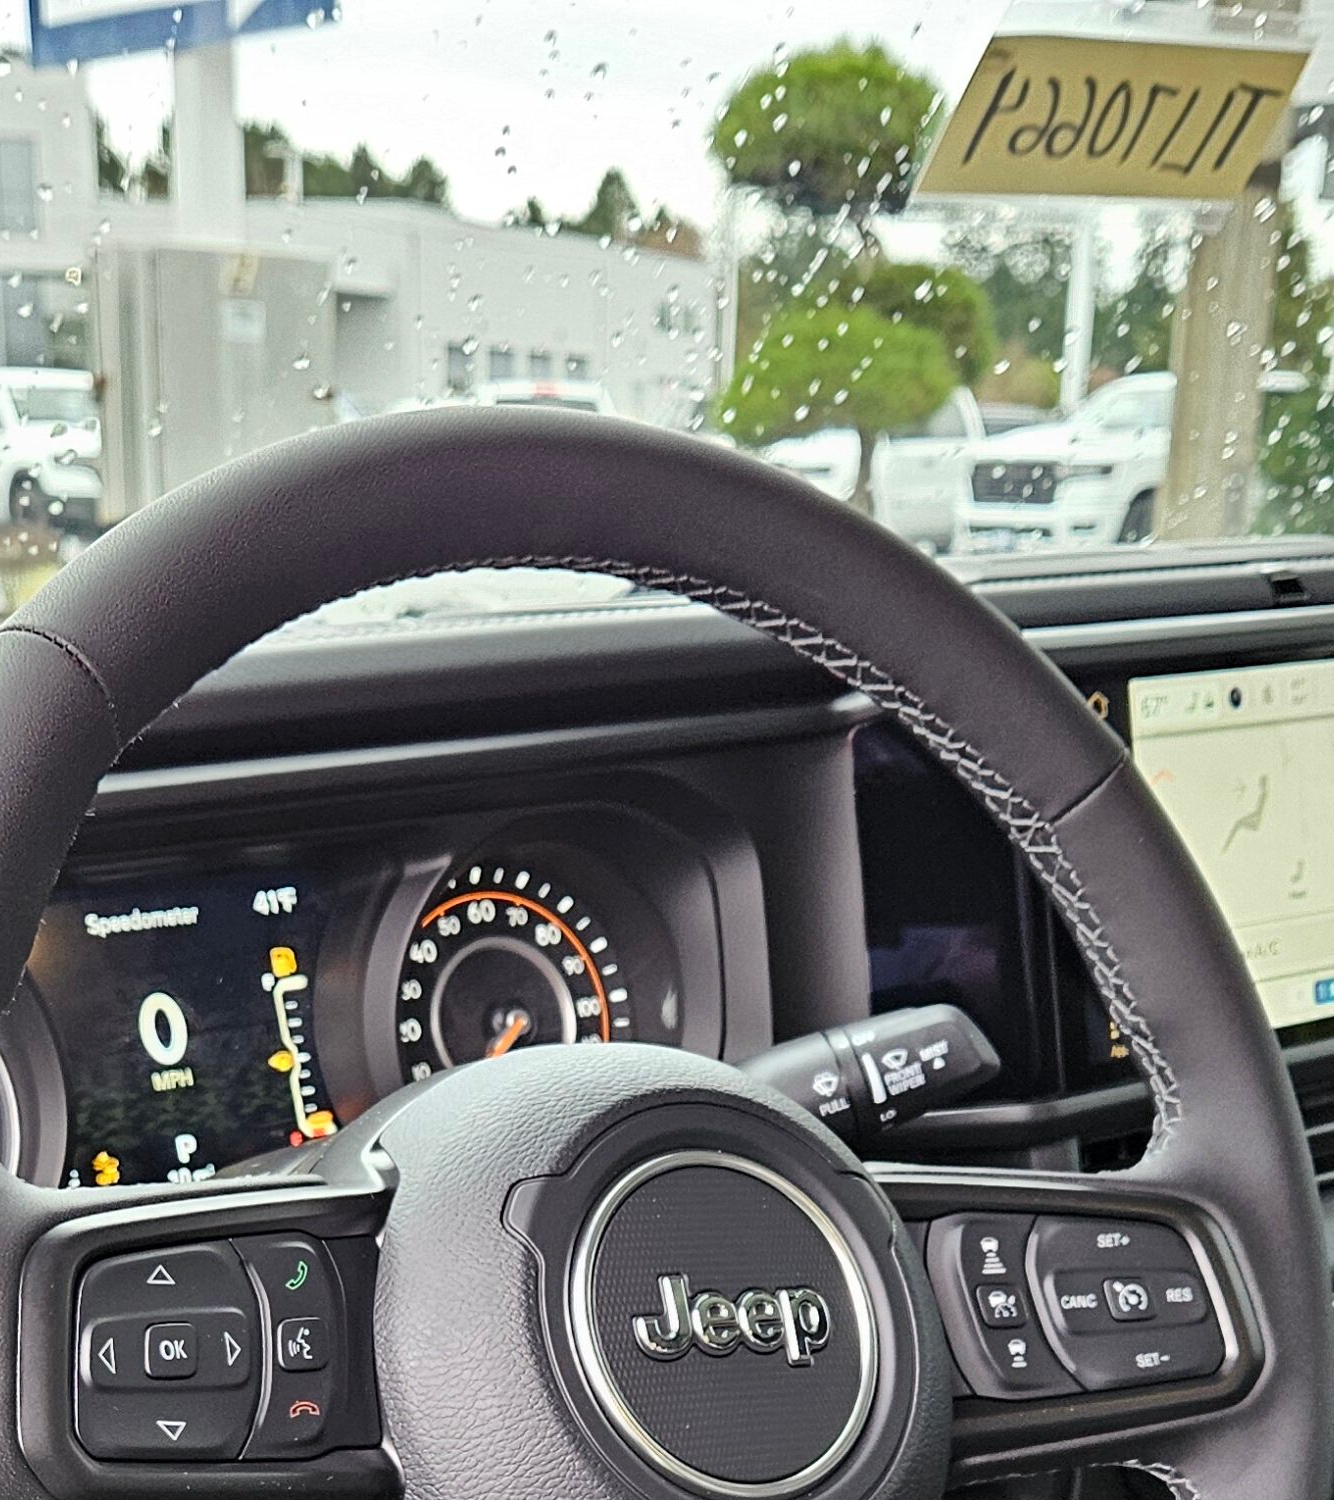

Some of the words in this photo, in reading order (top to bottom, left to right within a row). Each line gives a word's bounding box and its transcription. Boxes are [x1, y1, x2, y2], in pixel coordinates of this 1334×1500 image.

[85, 906, 199, 938] Speedometer
[467, 899, 496, 925] 60
[506, 905, 528, 927] 70
[437, 915, 461, 937] 50
[535, 922, 562, 947] 80
[409, 939, 437, 964] 40
[562, 955, 585, 976] 90
[577, 996, 602, 1018] 100
[139, 992, 188, 1065] 0
[919, 1039, 948, 1061] MIST
[151, 1067, 194, 1092] MPH
[884, 1061, 922, 1086] FRONT
[887, 1073, 926, 1096] WIPER
[819, 1097, 851, 1117] PULL
[175, 1133, 197, 1164] P
[1061, 1293, 1098, 1309] CANC
[1166, 1287, 1193, 1302] RES
[632, 1273, 831, 1368] Jeep
[159, 1340, 187, 1361] OK
